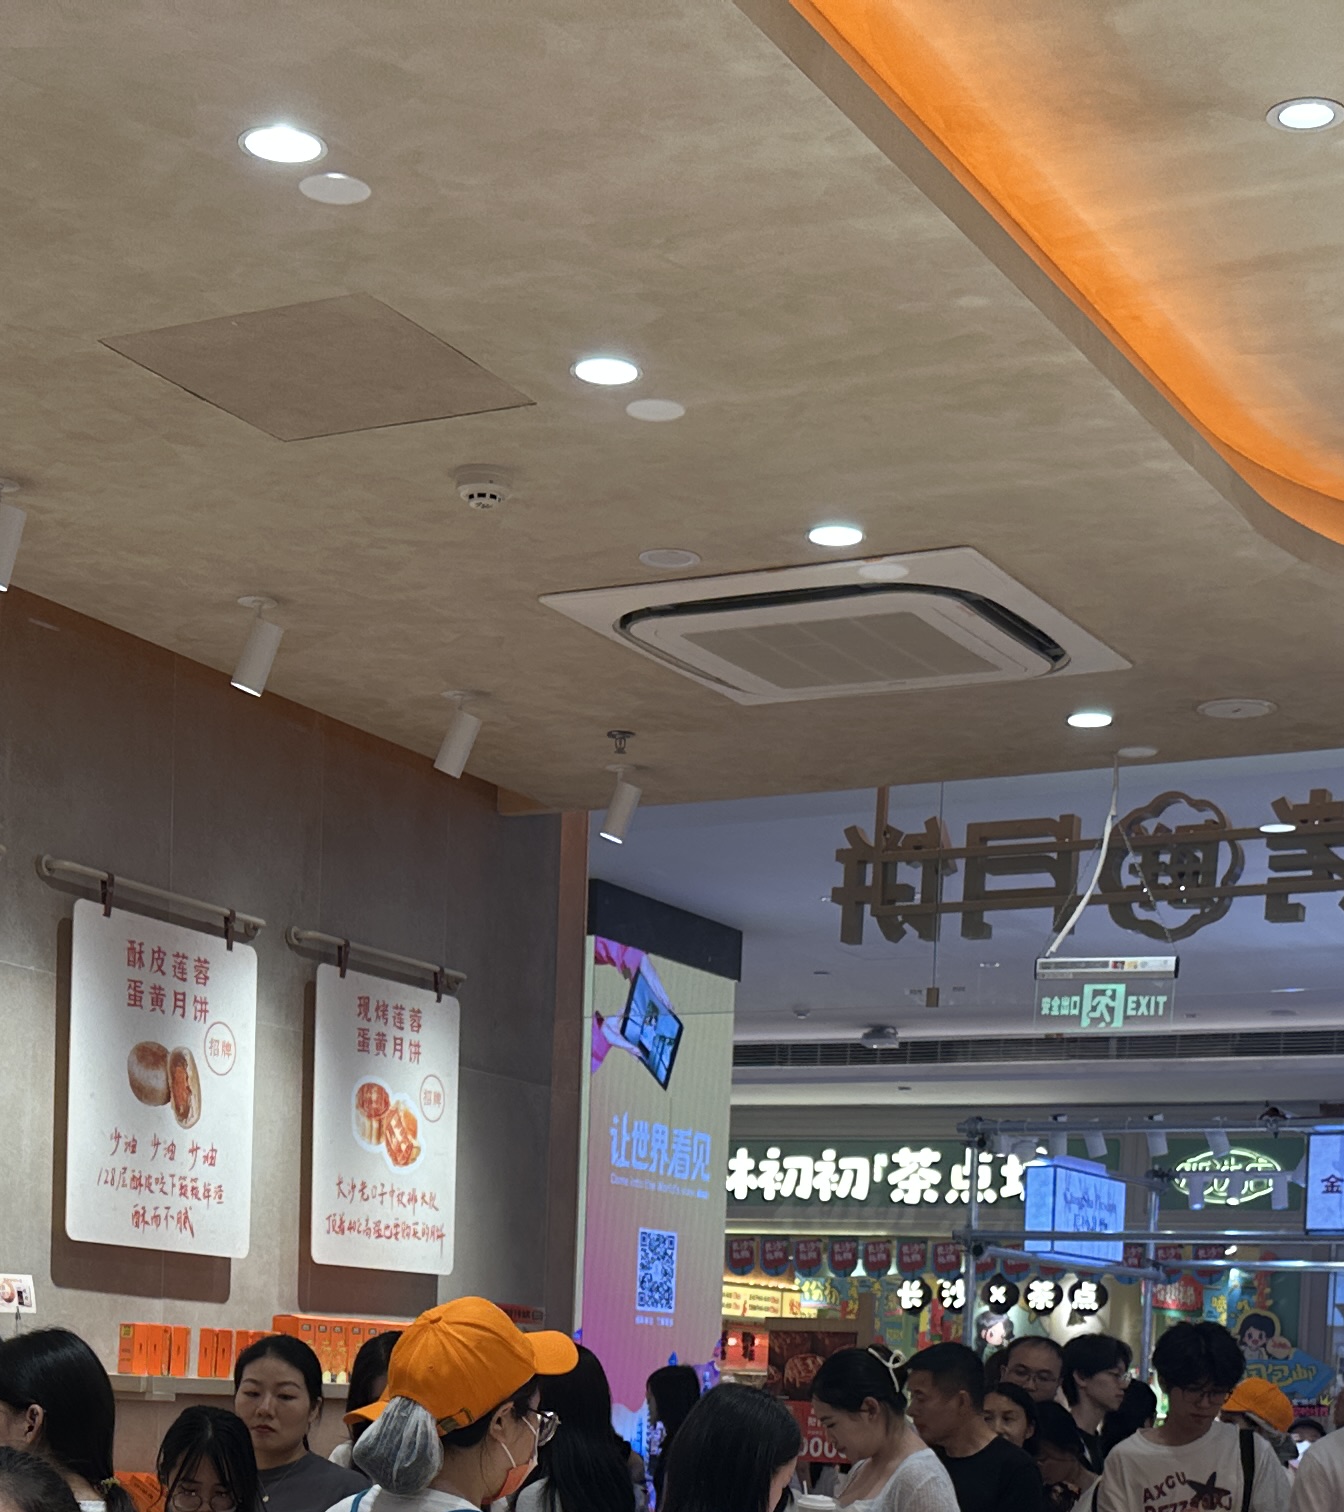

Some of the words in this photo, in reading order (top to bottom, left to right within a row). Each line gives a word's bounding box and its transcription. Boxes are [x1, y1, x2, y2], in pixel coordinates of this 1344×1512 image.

[127, 939, 211, 987] 酥皮莲蓉
[127, 979, 211, 1025] 蛋黄月饼
[357, 995, 422, 1034] 现烤莲蓉
[1041, 995, 1080, 1016] 安全出口
[1126, 995, 1168, 1016] EXIT
[208, 1037, 232, 1058] 招牌
[356, 1027, 422, 1064] 蛋黄月饼
[110, 1127, 137, 1156] 少油
[151, 1133, 176, 1162] 少油
[188, 1141, 217, 1167] 少油
[610, 1111, 711, 1182] 让世界看见
